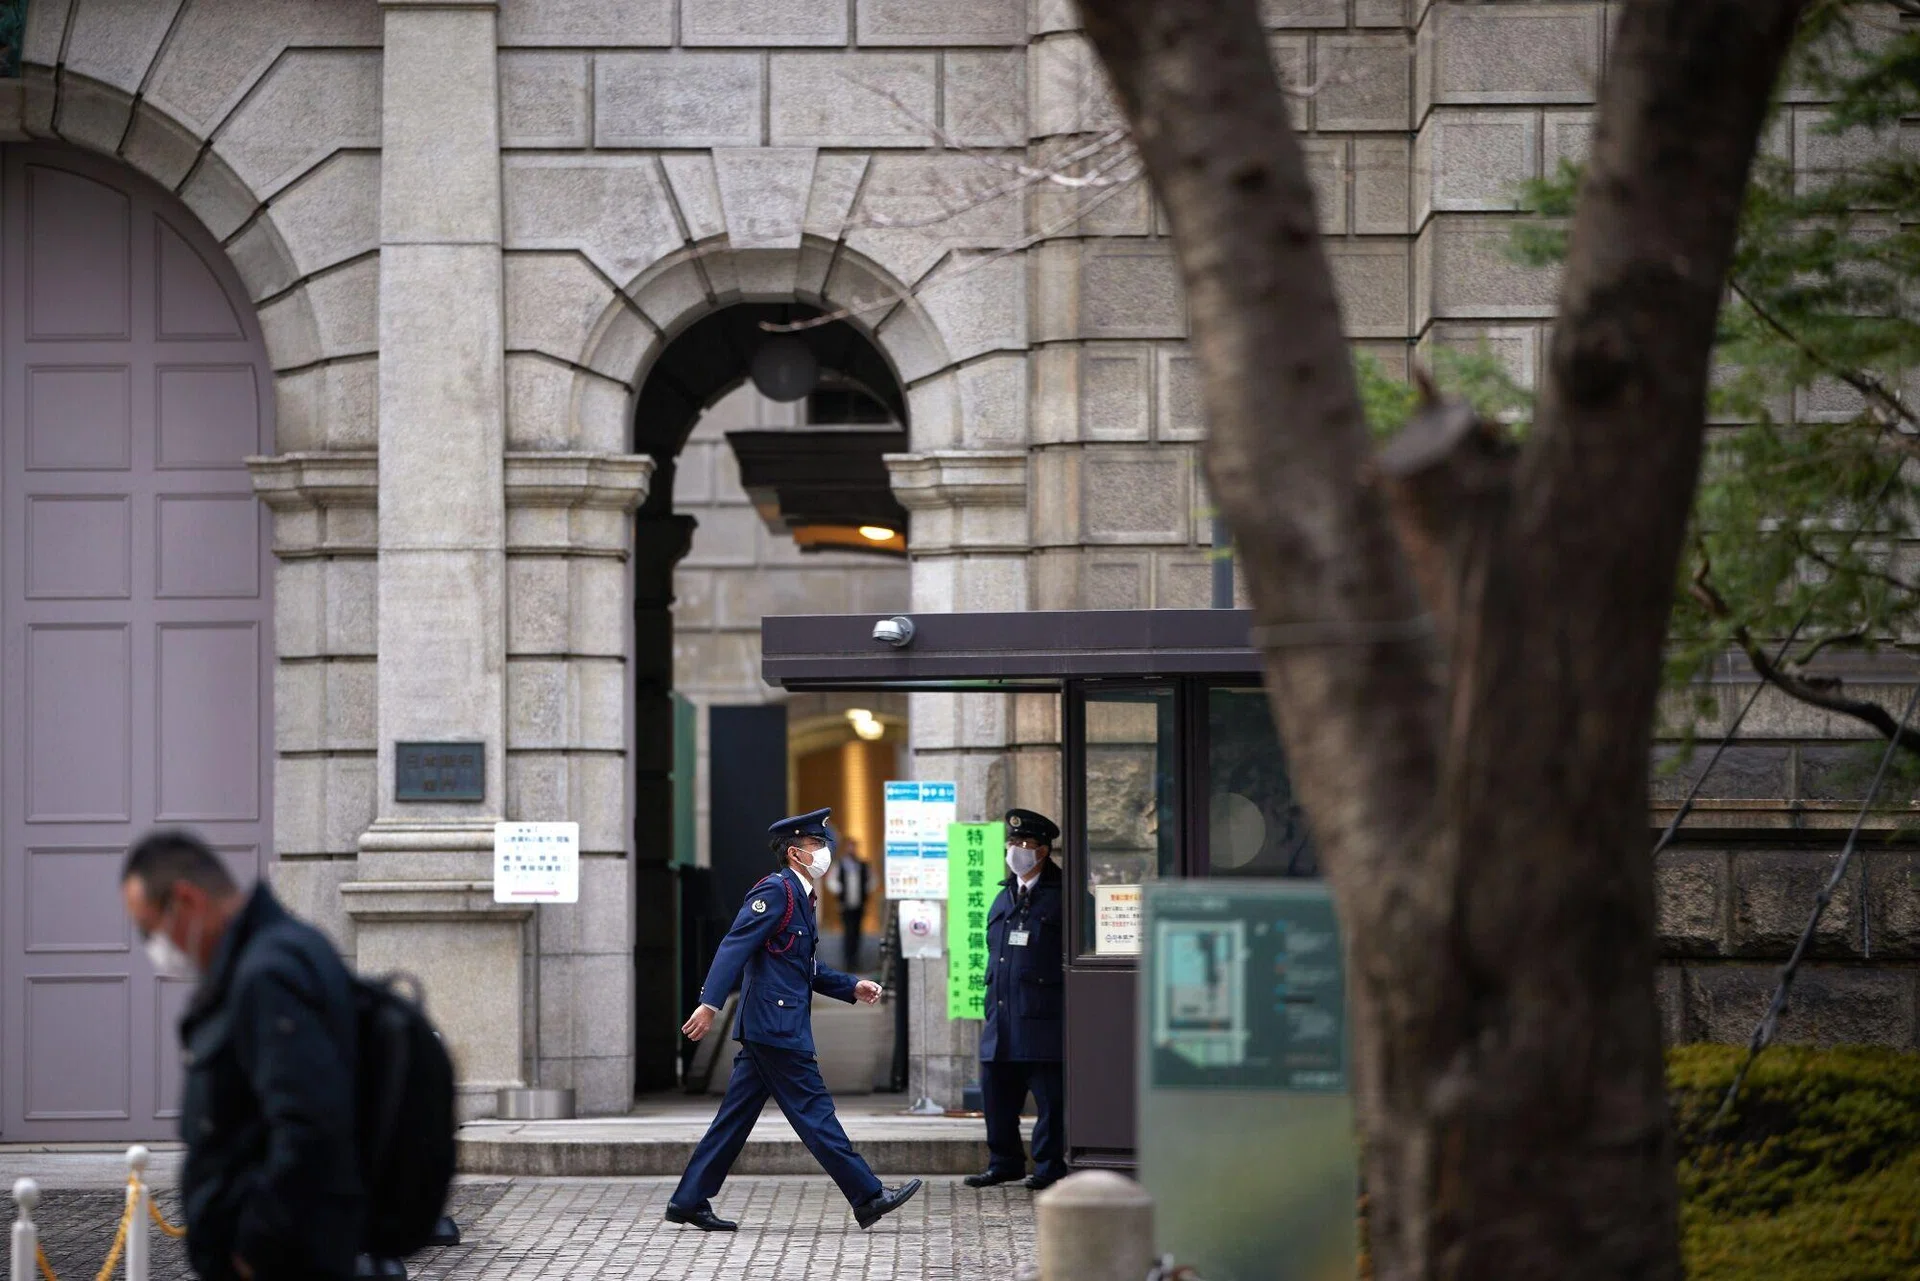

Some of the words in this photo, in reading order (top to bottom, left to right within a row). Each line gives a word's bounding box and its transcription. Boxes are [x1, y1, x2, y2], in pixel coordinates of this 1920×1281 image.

[967, 829, 985, 1012] 特別警戒警備実施中
